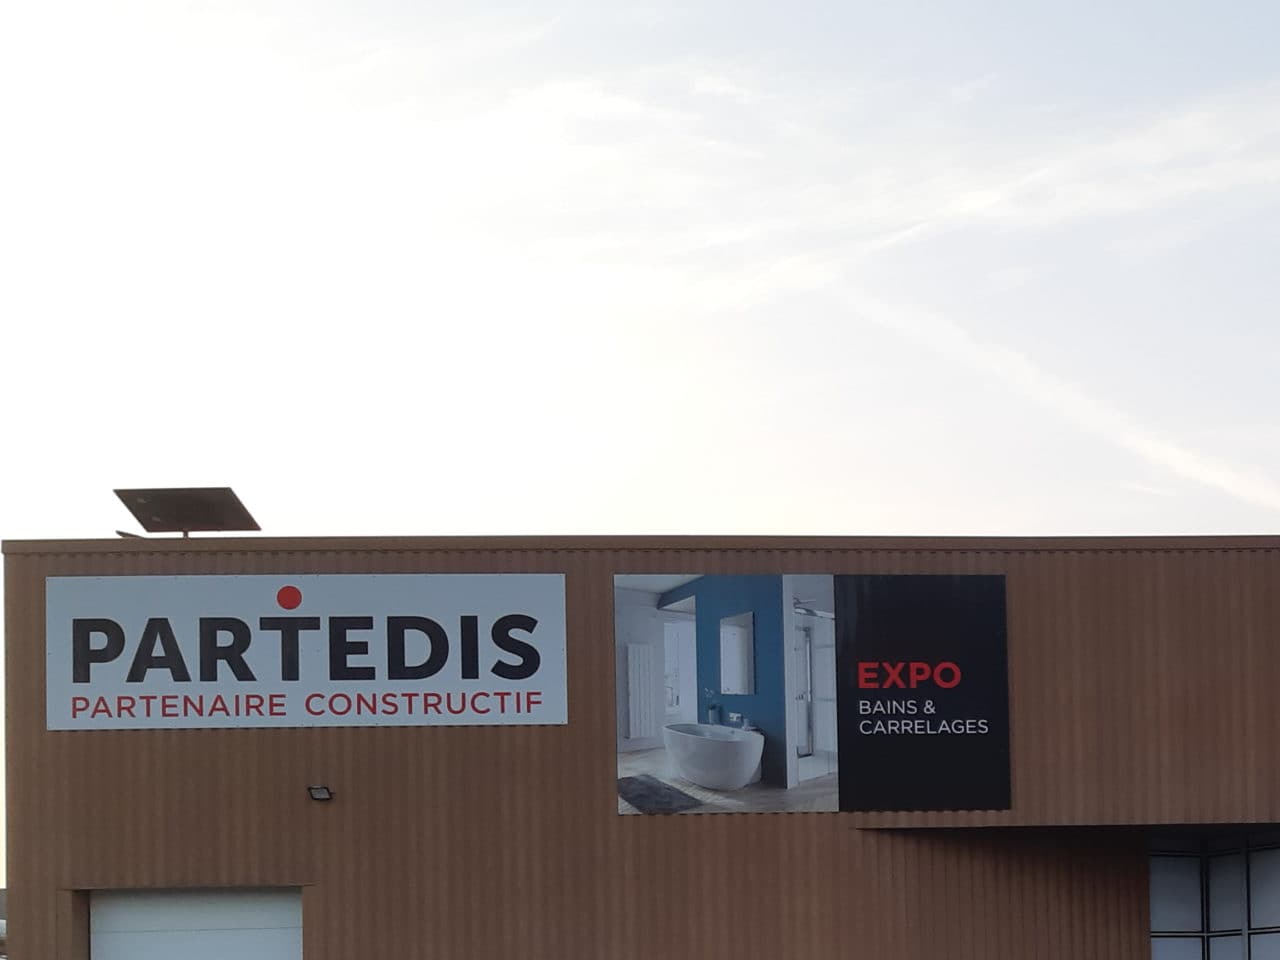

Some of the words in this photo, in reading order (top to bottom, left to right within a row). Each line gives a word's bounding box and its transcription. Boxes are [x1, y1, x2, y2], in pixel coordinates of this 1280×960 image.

[72, 614, 541, 683] PARTEDIS
[858, 661, 961, 689] EXPO
[72, 694, 287, 718] PARTENAIRE
[304, 691, 543, 716] CONSTRUCTIF
[859, 700, 918, 715] BAINS
[924, 699, 936, 714] &
[859, 719, 989, 735] CARRELAGES
